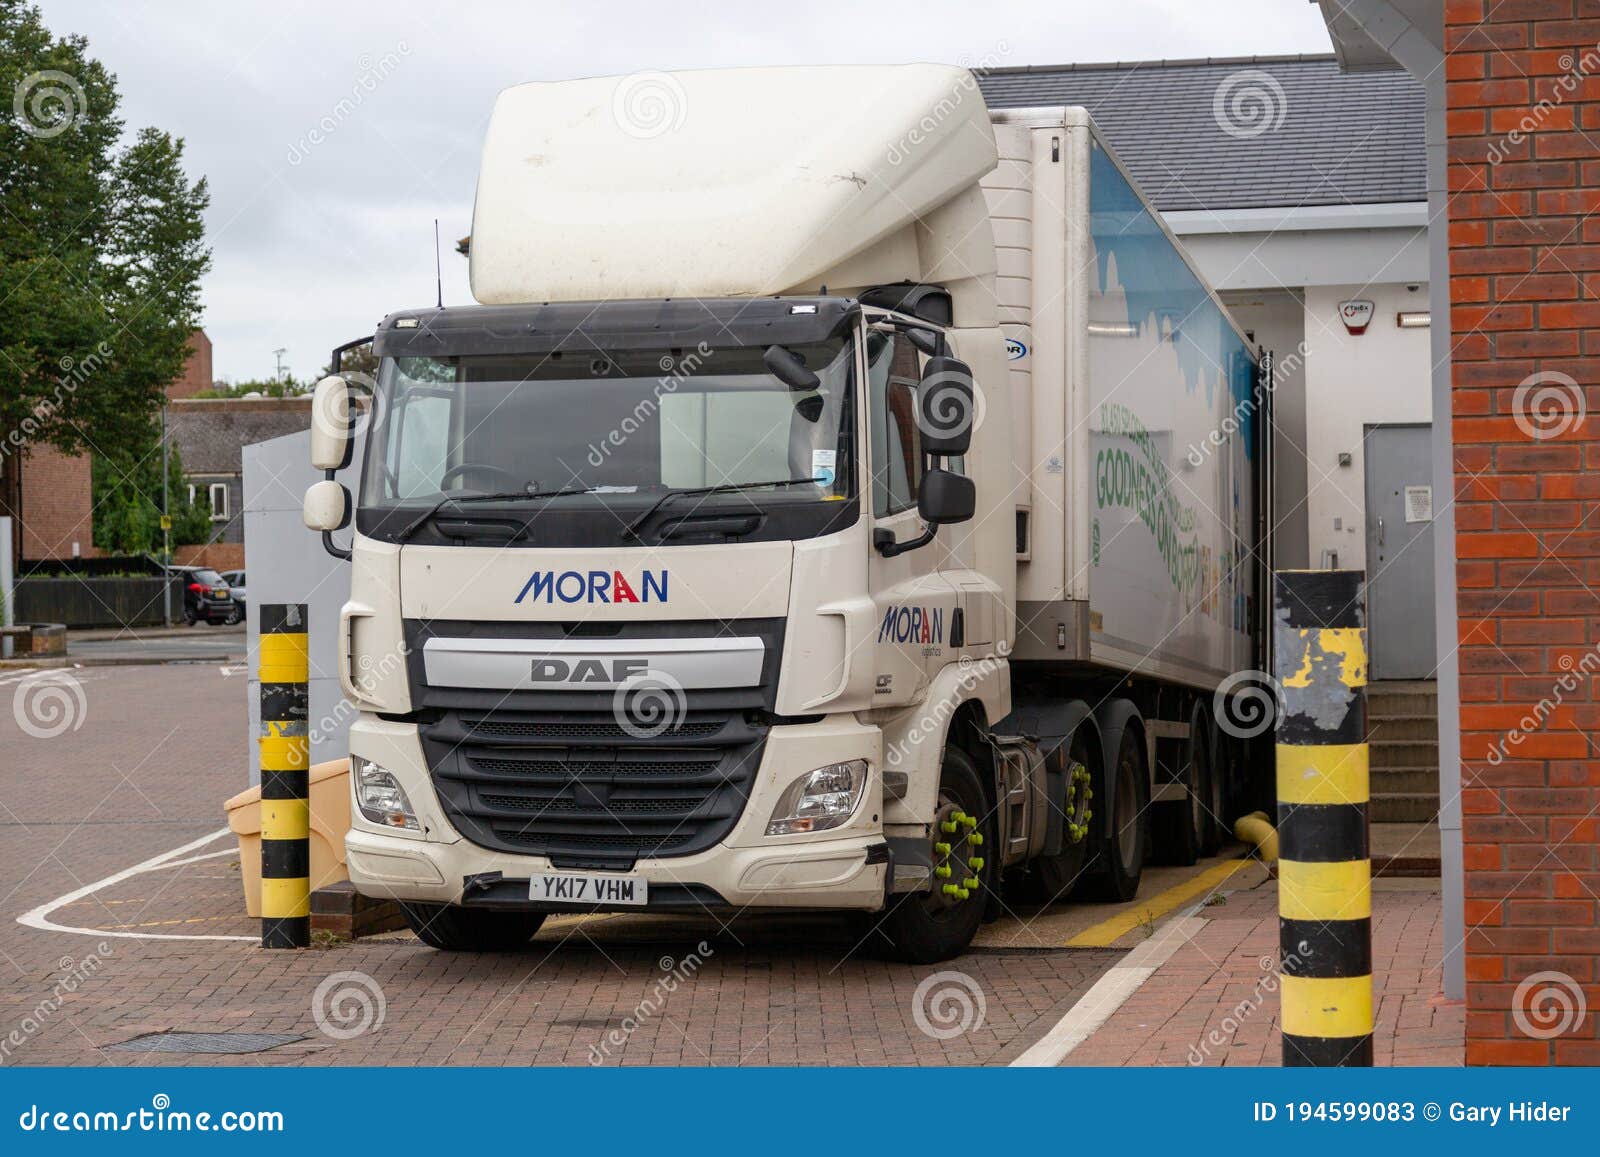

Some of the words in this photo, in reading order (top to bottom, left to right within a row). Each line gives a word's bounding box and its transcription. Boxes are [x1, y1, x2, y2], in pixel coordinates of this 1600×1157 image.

[1096, 447, 1156, 535] GOODNESS
[514, 570, 668, 603] MORAN
[878, 606, 943, 643] MORAN
[531, 659, 649, 682] DAF
[543, 877, 587, 898] YK17
[594, 879, 634, 900] VHM
